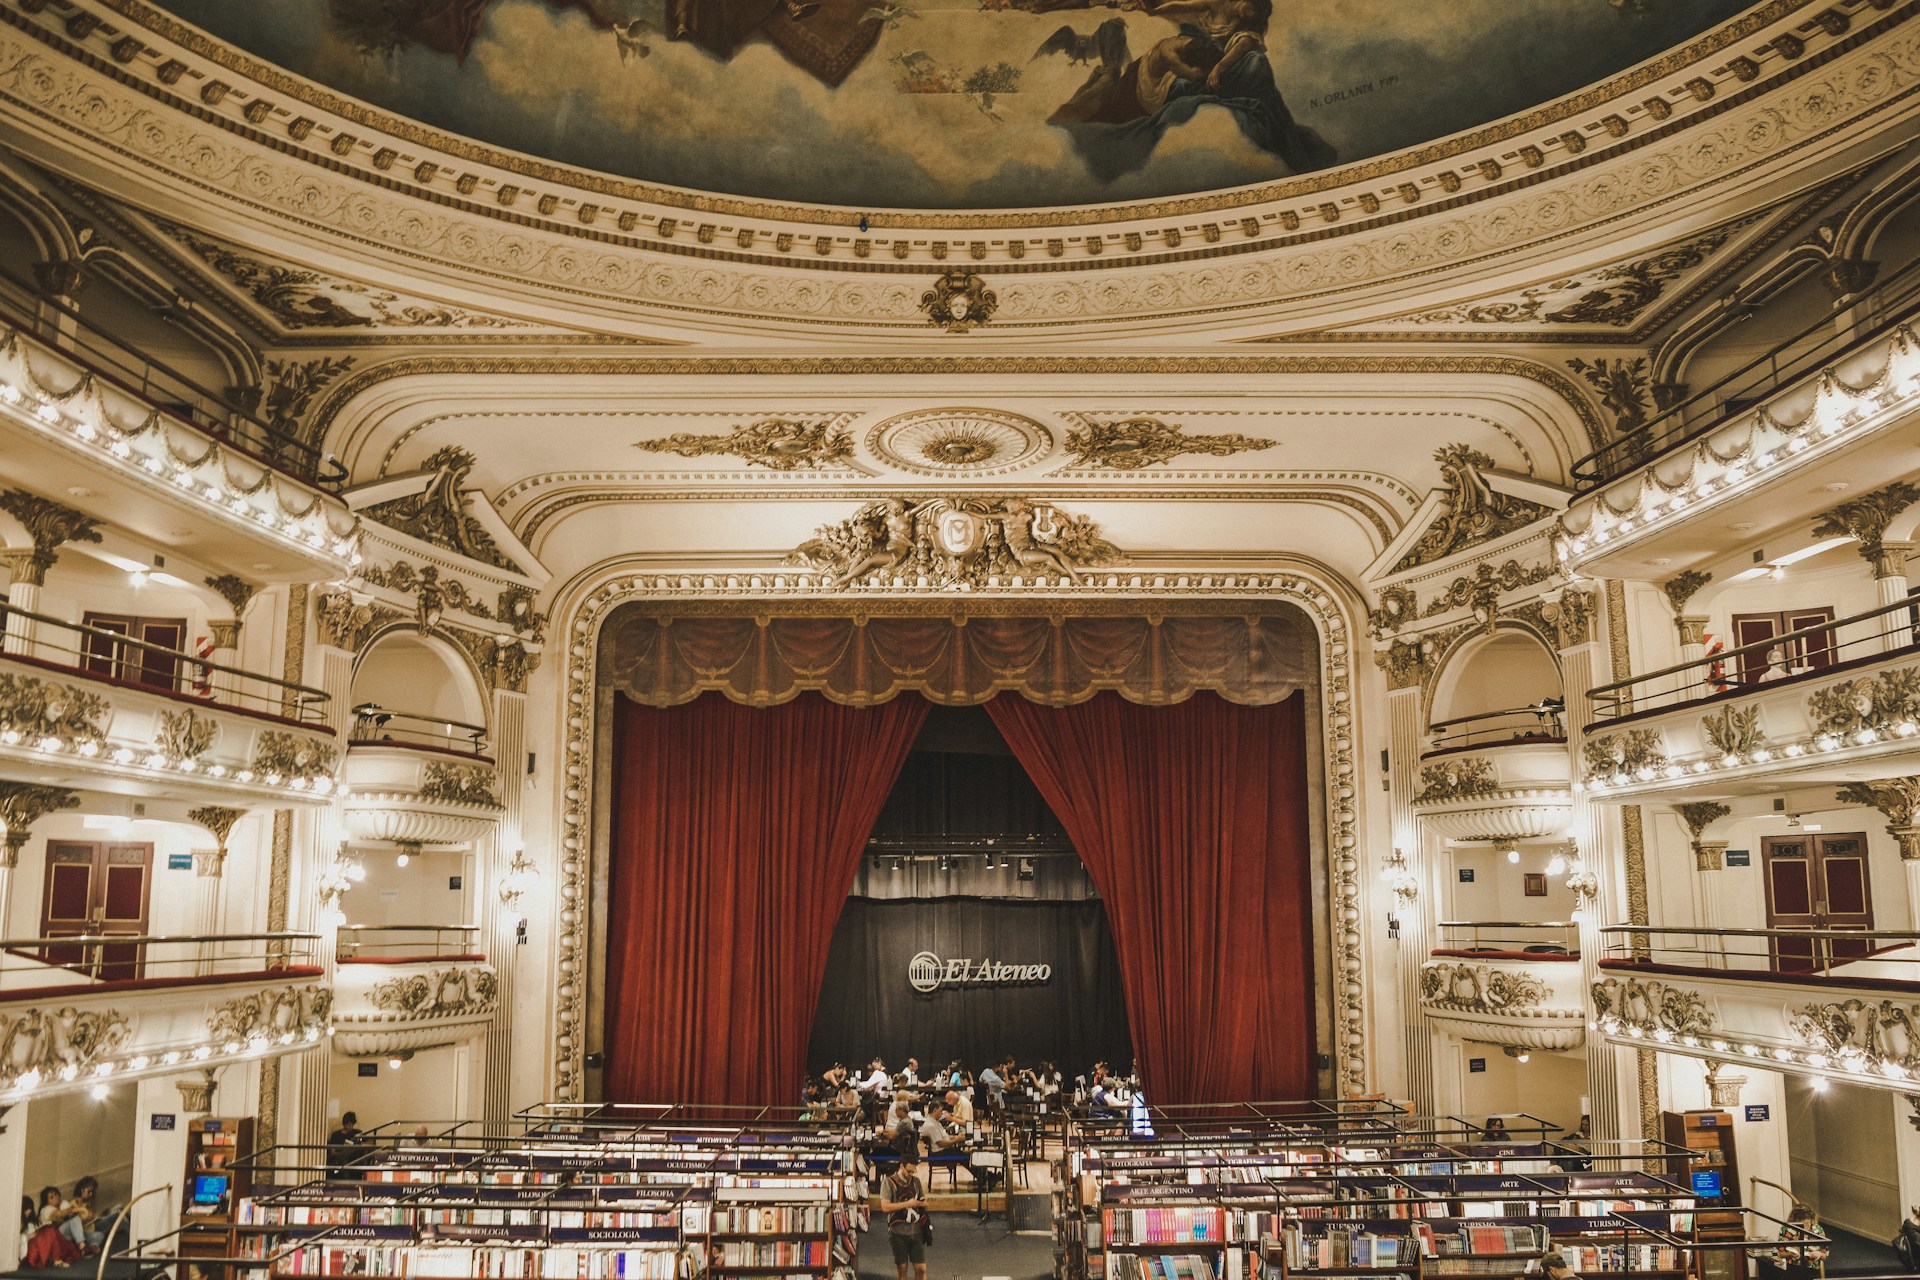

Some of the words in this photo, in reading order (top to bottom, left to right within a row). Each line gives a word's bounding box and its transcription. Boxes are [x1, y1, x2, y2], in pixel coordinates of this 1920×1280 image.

[942, 958, 971, 982] El
[972, 958, 1051, 982] Ateneo
[666, 1161, 706, 1169] OCULTISMO
[636, 1189, 674, 1197] FILOSOFIA
[1149, 1187, 1194, 1195] ARGENTINO
[1588, 1220, 1625, 1228] TURISMO
[459, 1228, 509, 1236] SOCIOLOGIA
[588, 1230, 640, 1239] SOCIOLOGIA
